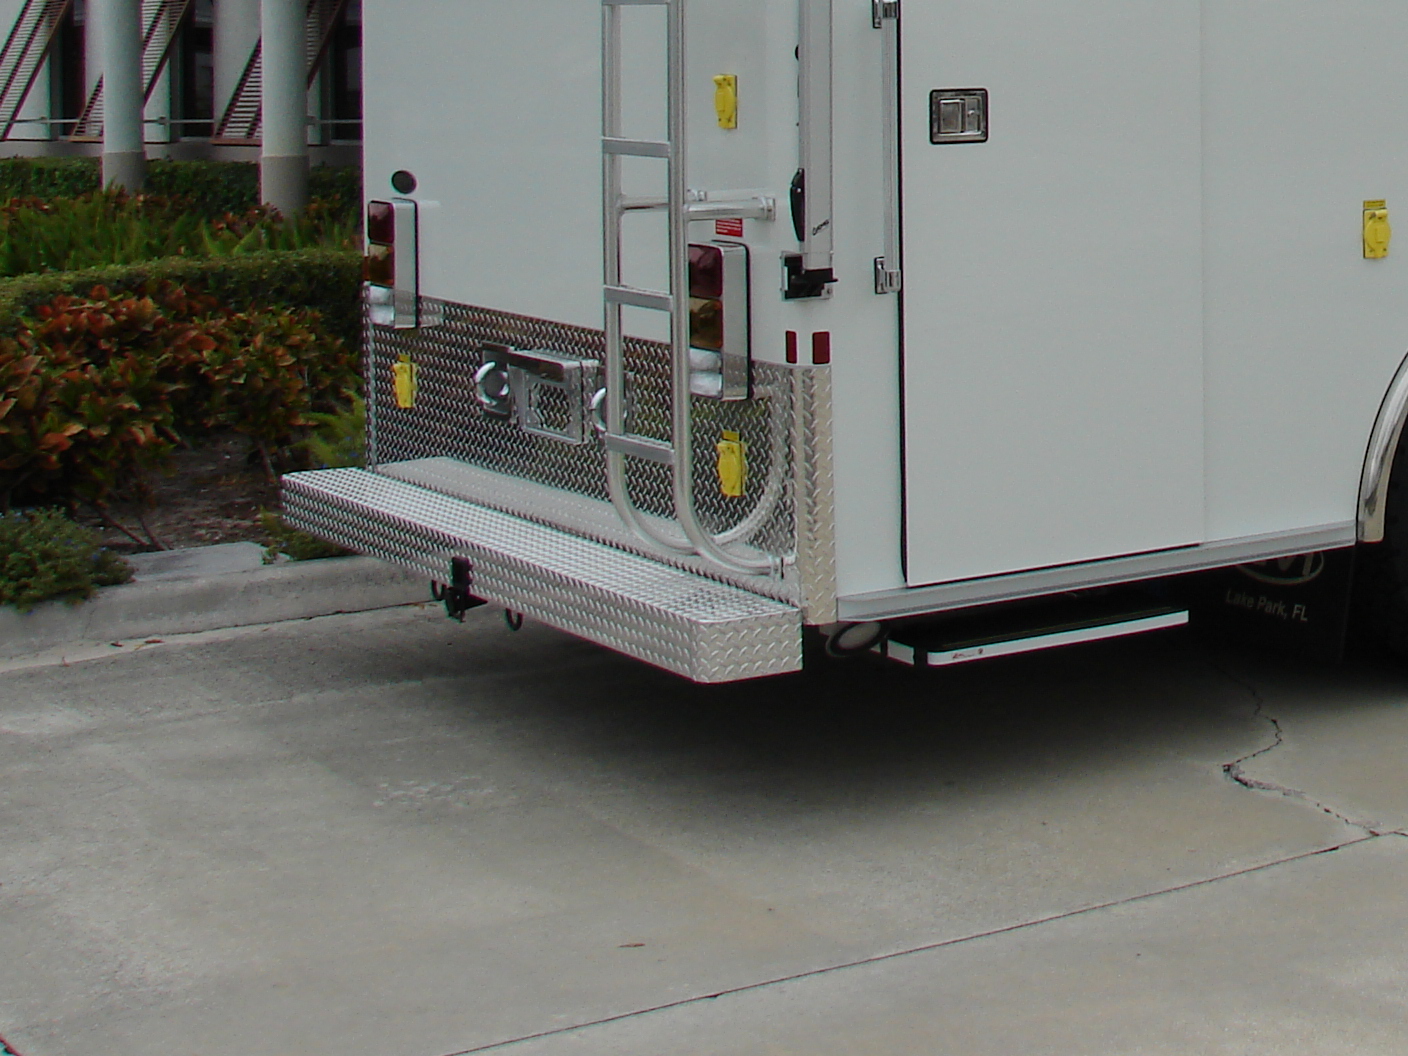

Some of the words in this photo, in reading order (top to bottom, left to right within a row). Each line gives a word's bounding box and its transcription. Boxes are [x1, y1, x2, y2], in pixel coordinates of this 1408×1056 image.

[1225, 588, 1255, 608] Lake
[1256, 594, 1288, 620] Park,
[1291, 603, 1308, 622] FL
